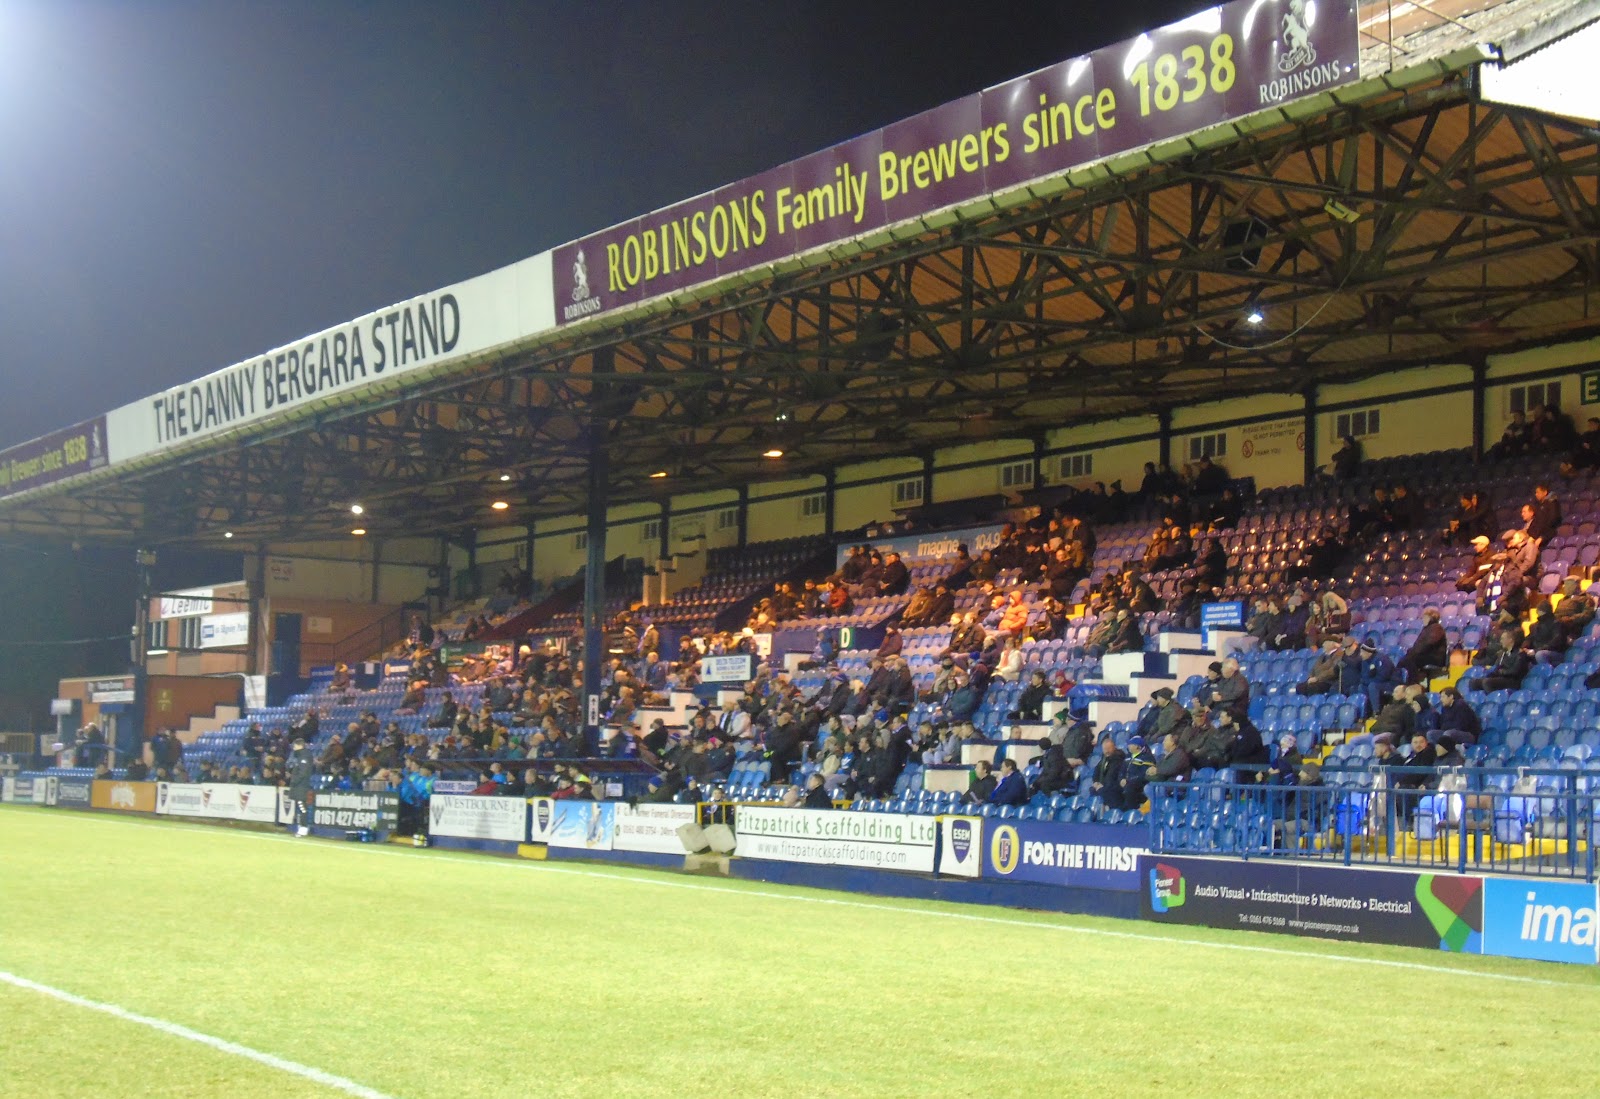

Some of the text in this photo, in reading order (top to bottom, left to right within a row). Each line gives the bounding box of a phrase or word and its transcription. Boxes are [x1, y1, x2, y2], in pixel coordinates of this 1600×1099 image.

[1259, 60, 1341, 103] ROBINSONS
[606, 33, 1236, 292] ROBINSONS Family Brewers since 1838
[153, 292, 461, 444] THE DANNY BERGARA STAND
[917, 536, 960, 559] imagine
[841, 628, 851, 648] D
[443, 795, 510, 812] WESTBOURNE
[314, 810, 336, 825] 0161
[336, 811, 353, 827] 427
[738, 812, 935, 843] Fitzpatrick Scaffolding Ltd
[757, 840, 907, 865] www.fitzpatrickscaffolding.com
[1023, 841, 1055, 866] FOR
[1056, 843, 1084, 868] THE
[1195, 885, 1412, 914] Audio Visual Infrastructure & Networks Electrical
